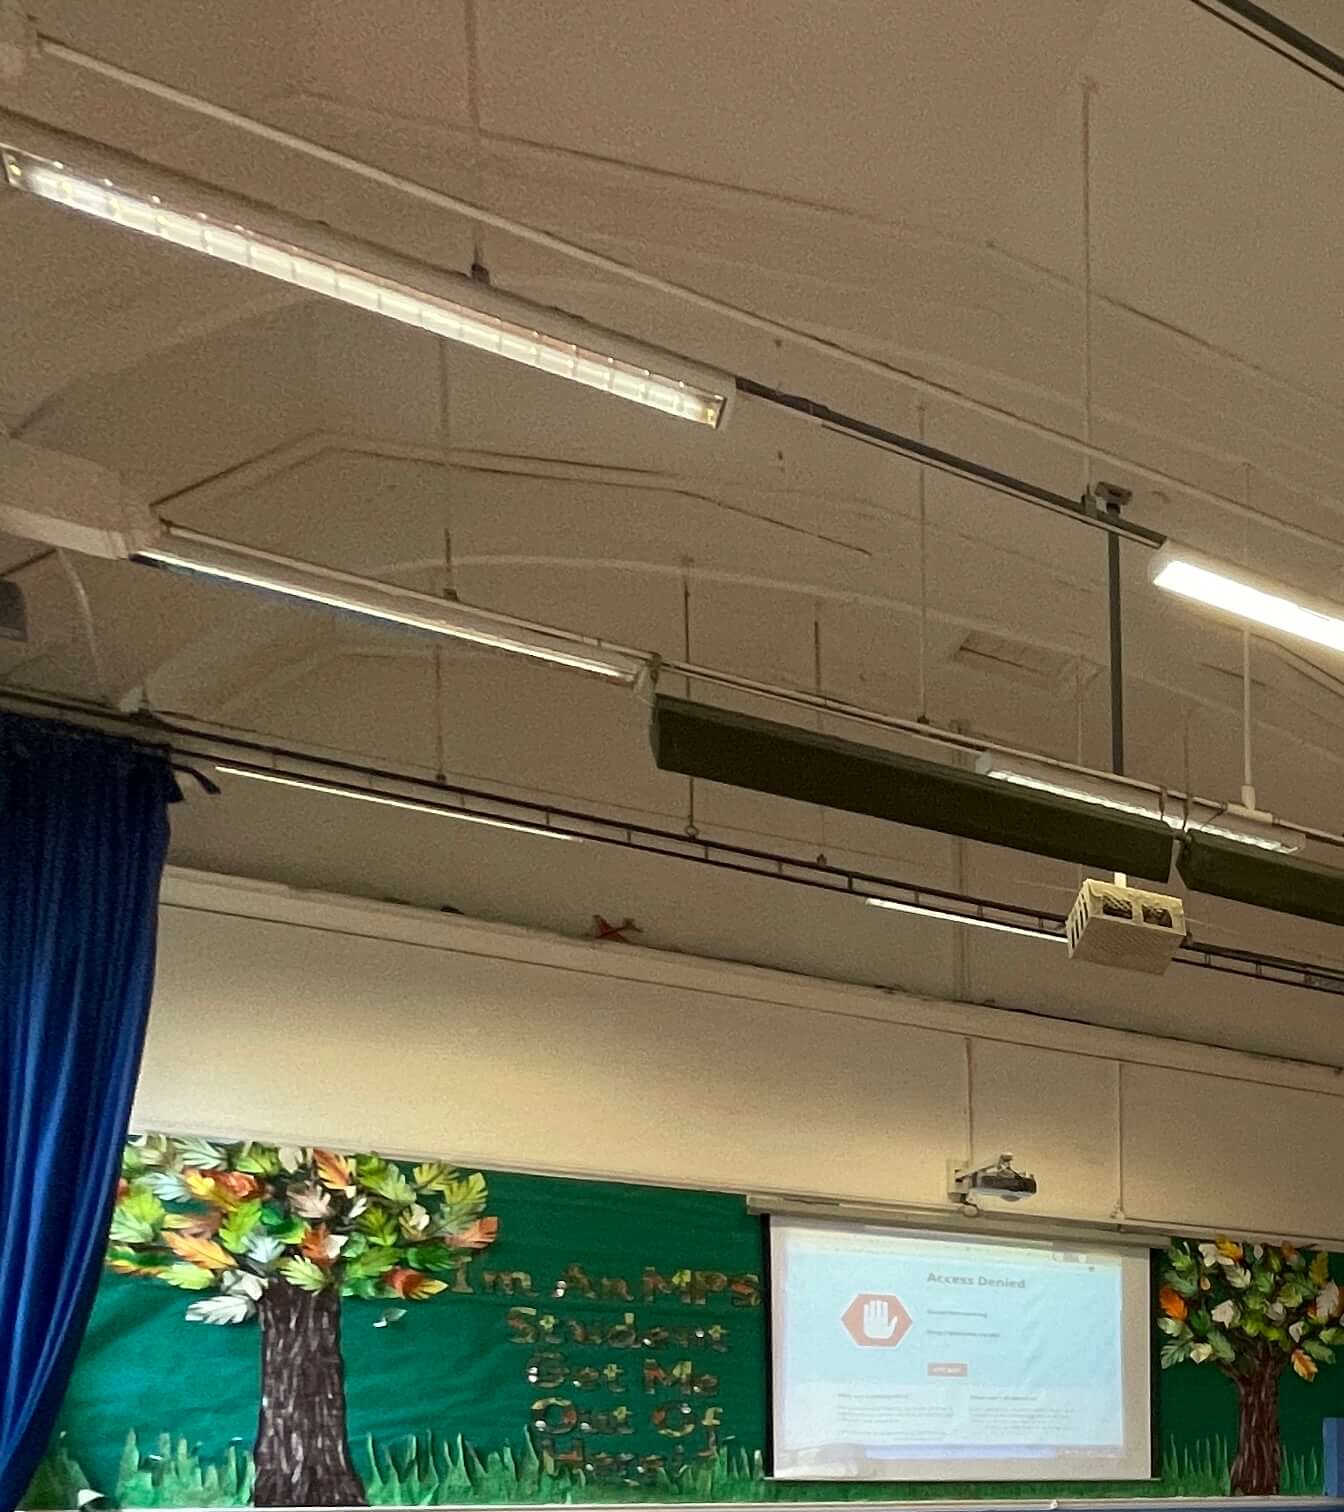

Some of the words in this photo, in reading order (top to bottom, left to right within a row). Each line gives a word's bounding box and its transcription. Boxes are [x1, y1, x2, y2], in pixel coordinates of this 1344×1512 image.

[927, 1272, 974, 1286] Access
[978, 1276, 1026, 1289] Denied
[507, 1306, 728, 1352] Student
